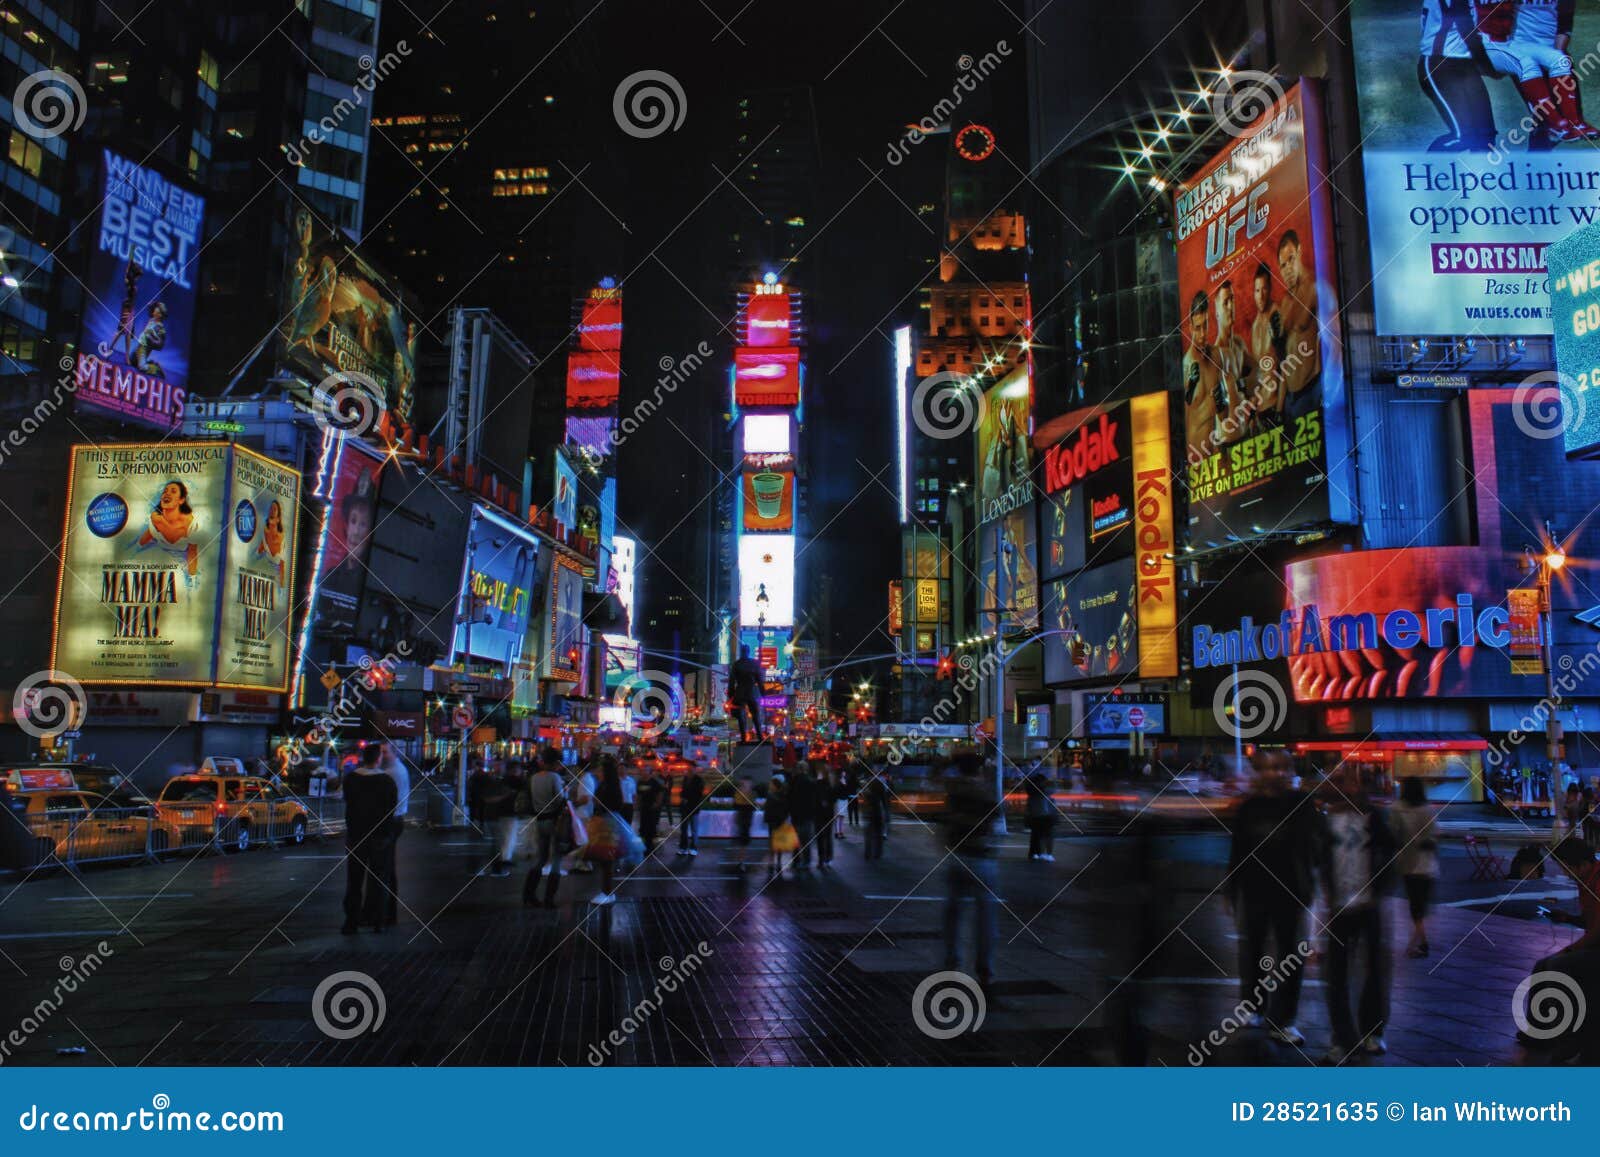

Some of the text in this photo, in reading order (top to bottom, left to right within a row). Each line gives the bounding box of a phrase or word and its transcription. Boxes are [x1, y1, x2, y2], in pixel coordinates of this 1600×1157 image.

[1403, 162, 1519, 199] Helped
[102, 196, 196, 264] BEST
[1205, 180, 1269, 270] UFC
[1257, 203, 1270, 219] 119
[1410, 204, 1600, 234] opponent w
[100, 229, 192, 289] MUSICAL
[1485, 278, 1519, 295] Pass
[1524, 278, 1538, 294] It
[1465, 307, 1542, 319] VALUES.COM
[77, 351, 186, 418] MEMPHIS
[738, 394, 797, 406] TOSHIBA
[113, 450, 173, 462] FEEL-GOOD
[176, 448, 225, 461] MUSICAL
[1045, 413, 1120, 494] Kodak
[1189, 410, 1322, 488] SAT. SEPT. 25
[98, 463, 108, 475] IS
[111, 463, 119, 475] A
[1190, 483, 1213, 504] LIVE
[1216, 478, 1230, 493] ON
[1233, 441, 1322, 487] PAY-PER-VIEW
[1136, 468, 1170, 604] Kodak
[101, 571, 178, 604] MAMMA
[237, 573, 276, 611] MAMMA
[114, 605, 161, 639] MIA!
[242, 607, 267, 640] MIA!
[1192, 593, 1552, 669] Bank of Americ
[388, 719, 416, 729] MAC
